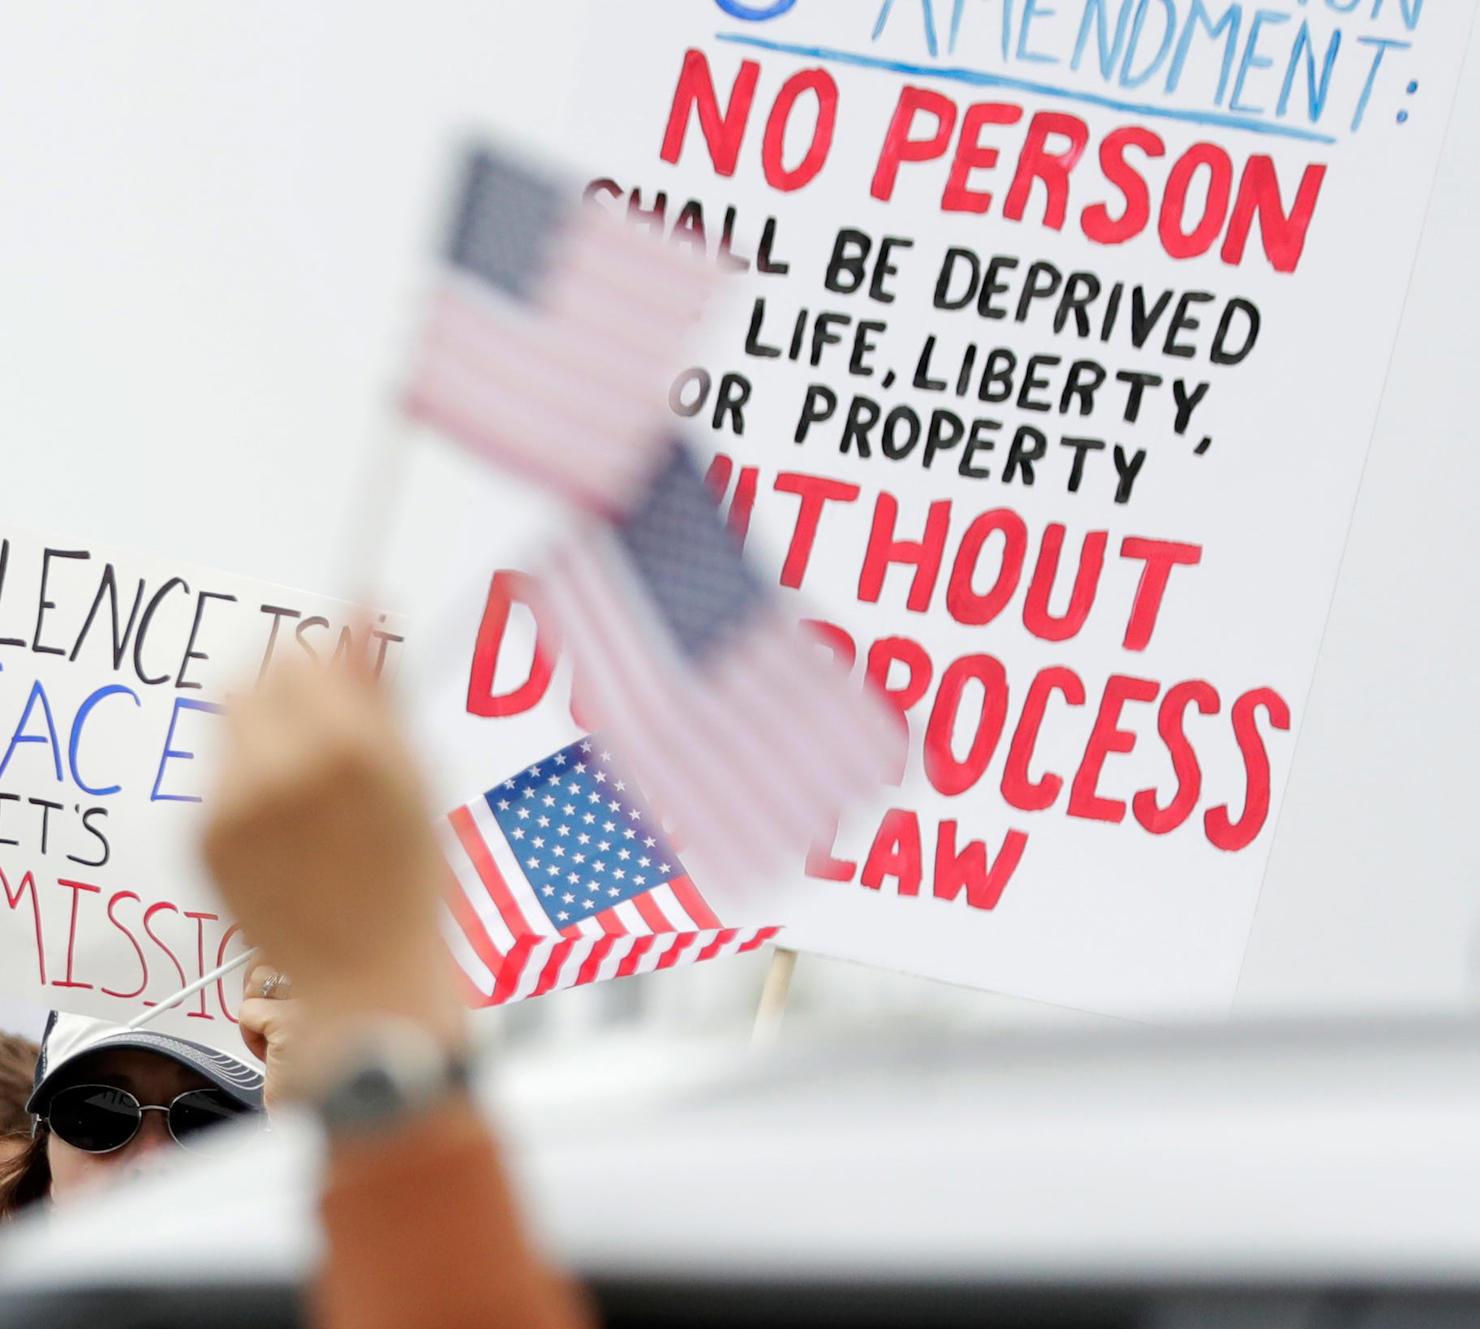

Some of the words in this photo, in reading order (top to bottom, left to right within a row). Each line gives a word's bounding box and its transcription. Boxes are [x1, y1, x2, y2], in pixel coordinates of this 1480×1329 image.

[660, 48, 840, 193] NO
[870, 84, 1328, 273] PERSON
[824, 227, 914, 306] BE
[932, 246, 1261, 366] DEPRIVED
[668, 366, 752, 438] OR
[795, 385, 1146, 504] PROPERTY
[704, 453, 1202, 652] ITHOUT
